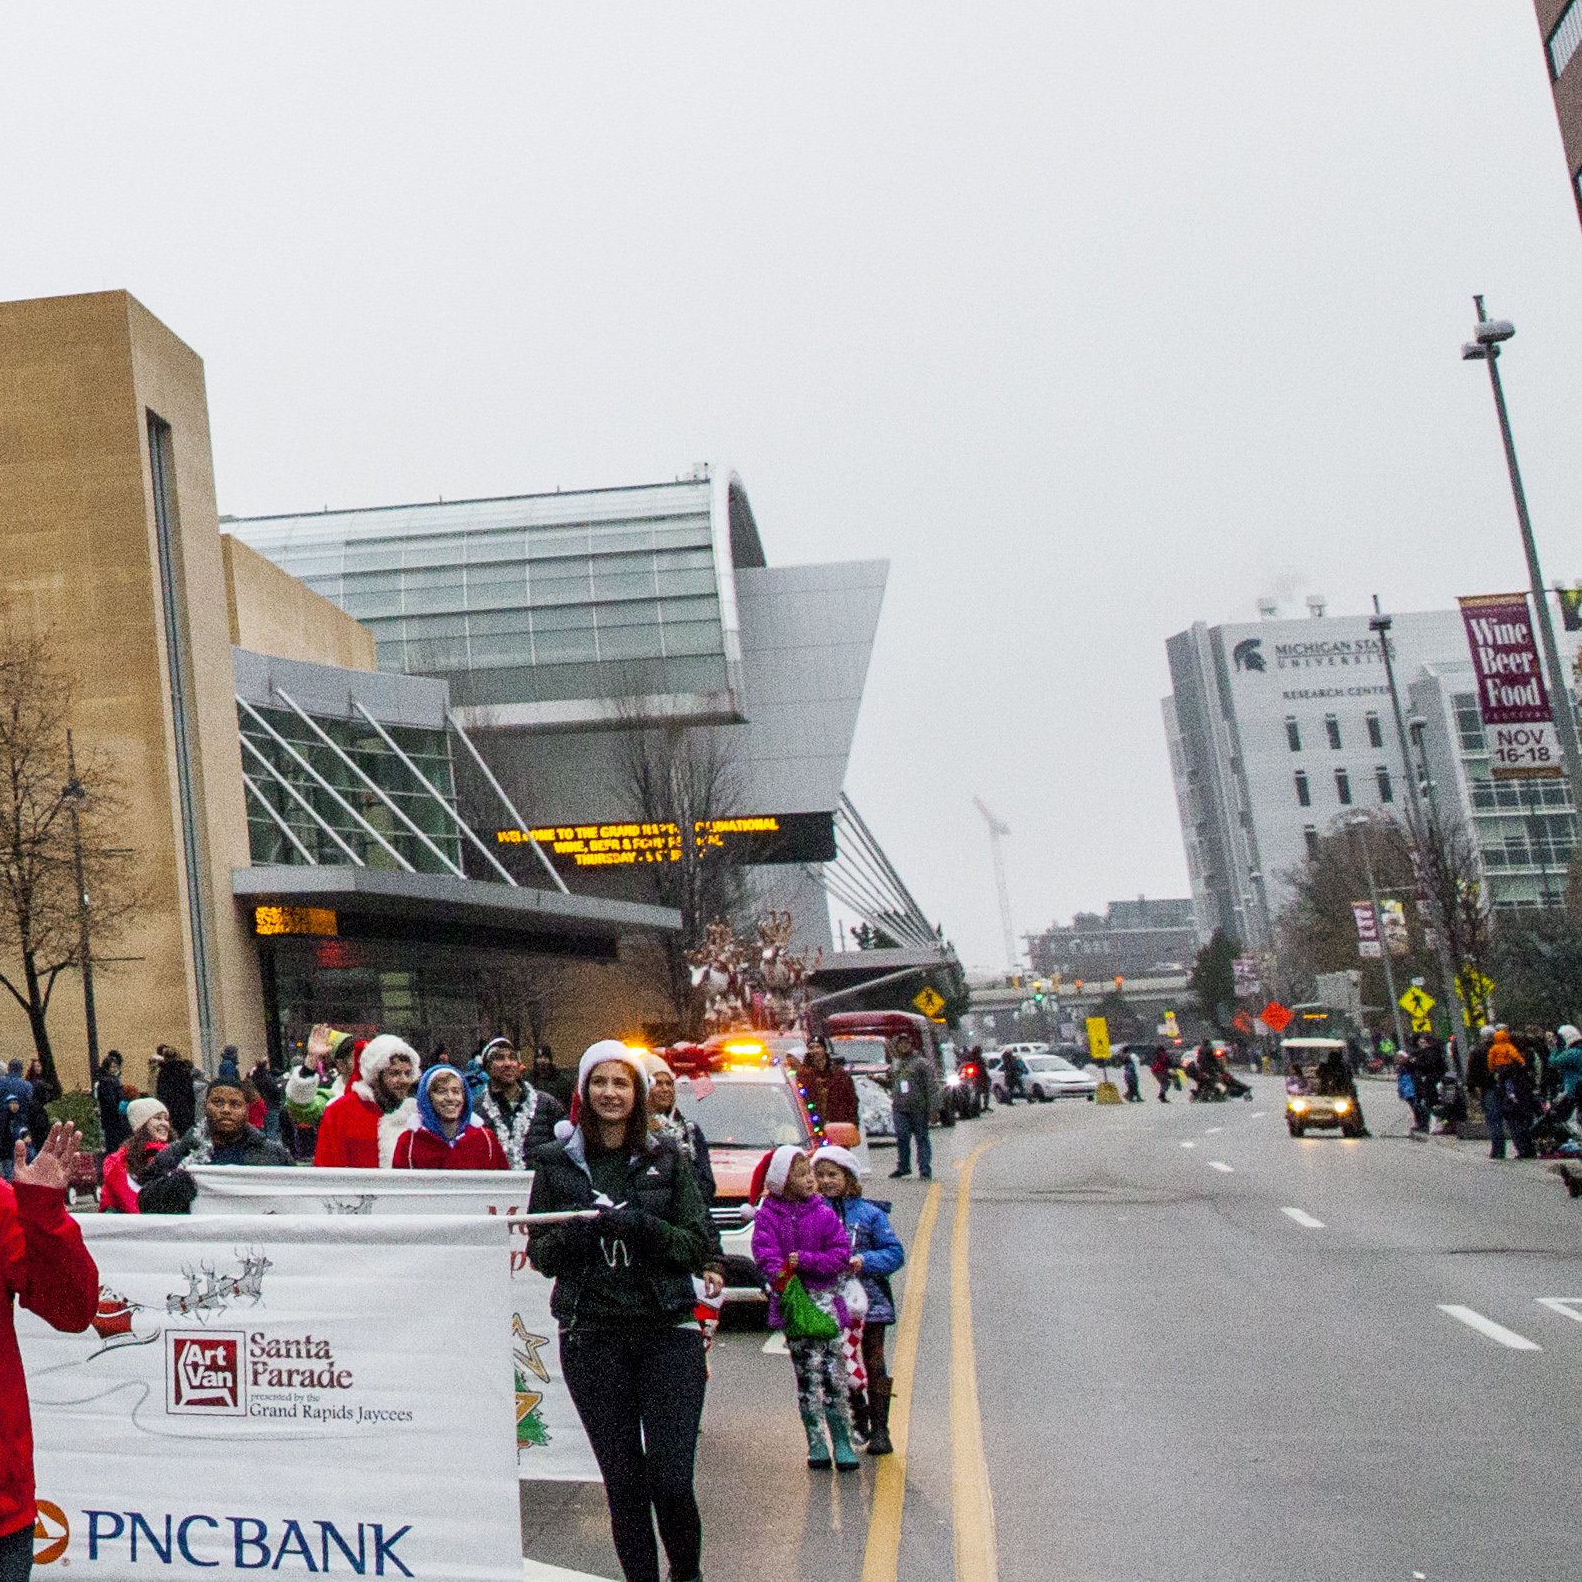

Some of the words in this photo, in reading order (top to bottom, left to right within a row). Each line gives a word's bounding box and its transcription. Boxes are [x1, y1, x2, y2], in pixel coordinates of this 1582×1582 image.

[1469, 618, 1528, 646] Wine
[1275, 641, 1352, 656] MICHIGAN
[1355, 638, 1396, 653] STAE
[1478, 646, 1535, 675] Beer
[1486, 676, 1542, 708] Food
[1495, 728, 1545, 747] NOV
[1495, 746, 1551, 763] 16-18
[556, 827, 574, 840] TO
[574, 826, 598, 839] THE
[599, 824, 639, 838] GRAND
[574, 851, 636, 866] THURSDAY
[185, 1344, 227, 1367] Art
[249, 1331, 334, 1360] Santa
[186, 1365, 234, 1388] Van
[250, 1360, 354, 1390] Parade
[250, 1392, 293, 1403] presented
[293, 1393, 305, 1404] by
[306, 1394, 320, 1403] the
[249, 1401, 297, 1419] Grand
[302, 1403, 354, 1423] Rapids
[356, 1405, 414, 1425] Jaycees
